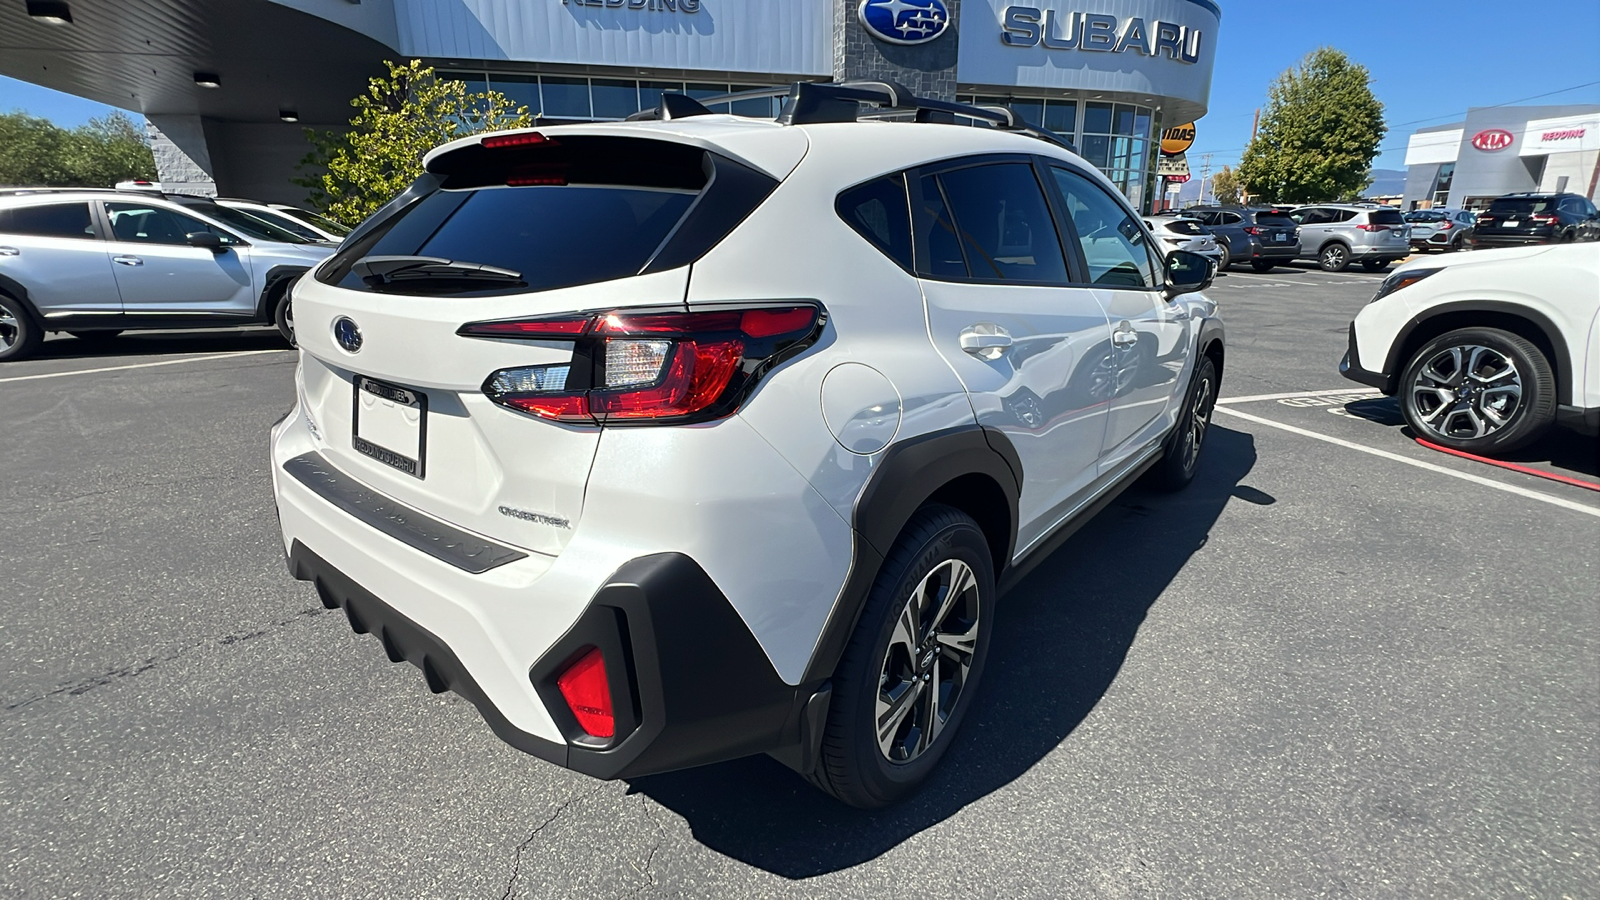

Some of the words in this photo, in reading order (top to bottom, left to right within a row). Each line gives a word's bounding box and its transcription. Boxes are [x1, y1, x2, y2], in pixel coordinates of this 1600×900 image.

[1001, 6, 1202, 64] SUBARU
[1479, 133, 1506, 147] KIA
[1541, 129, 1586, 142] REDDING
[356, 440, 384, 459] REDDING
[384, 451, 415, 473] SUBARU
[887, 545, 940, 625] YOKOHAMA
